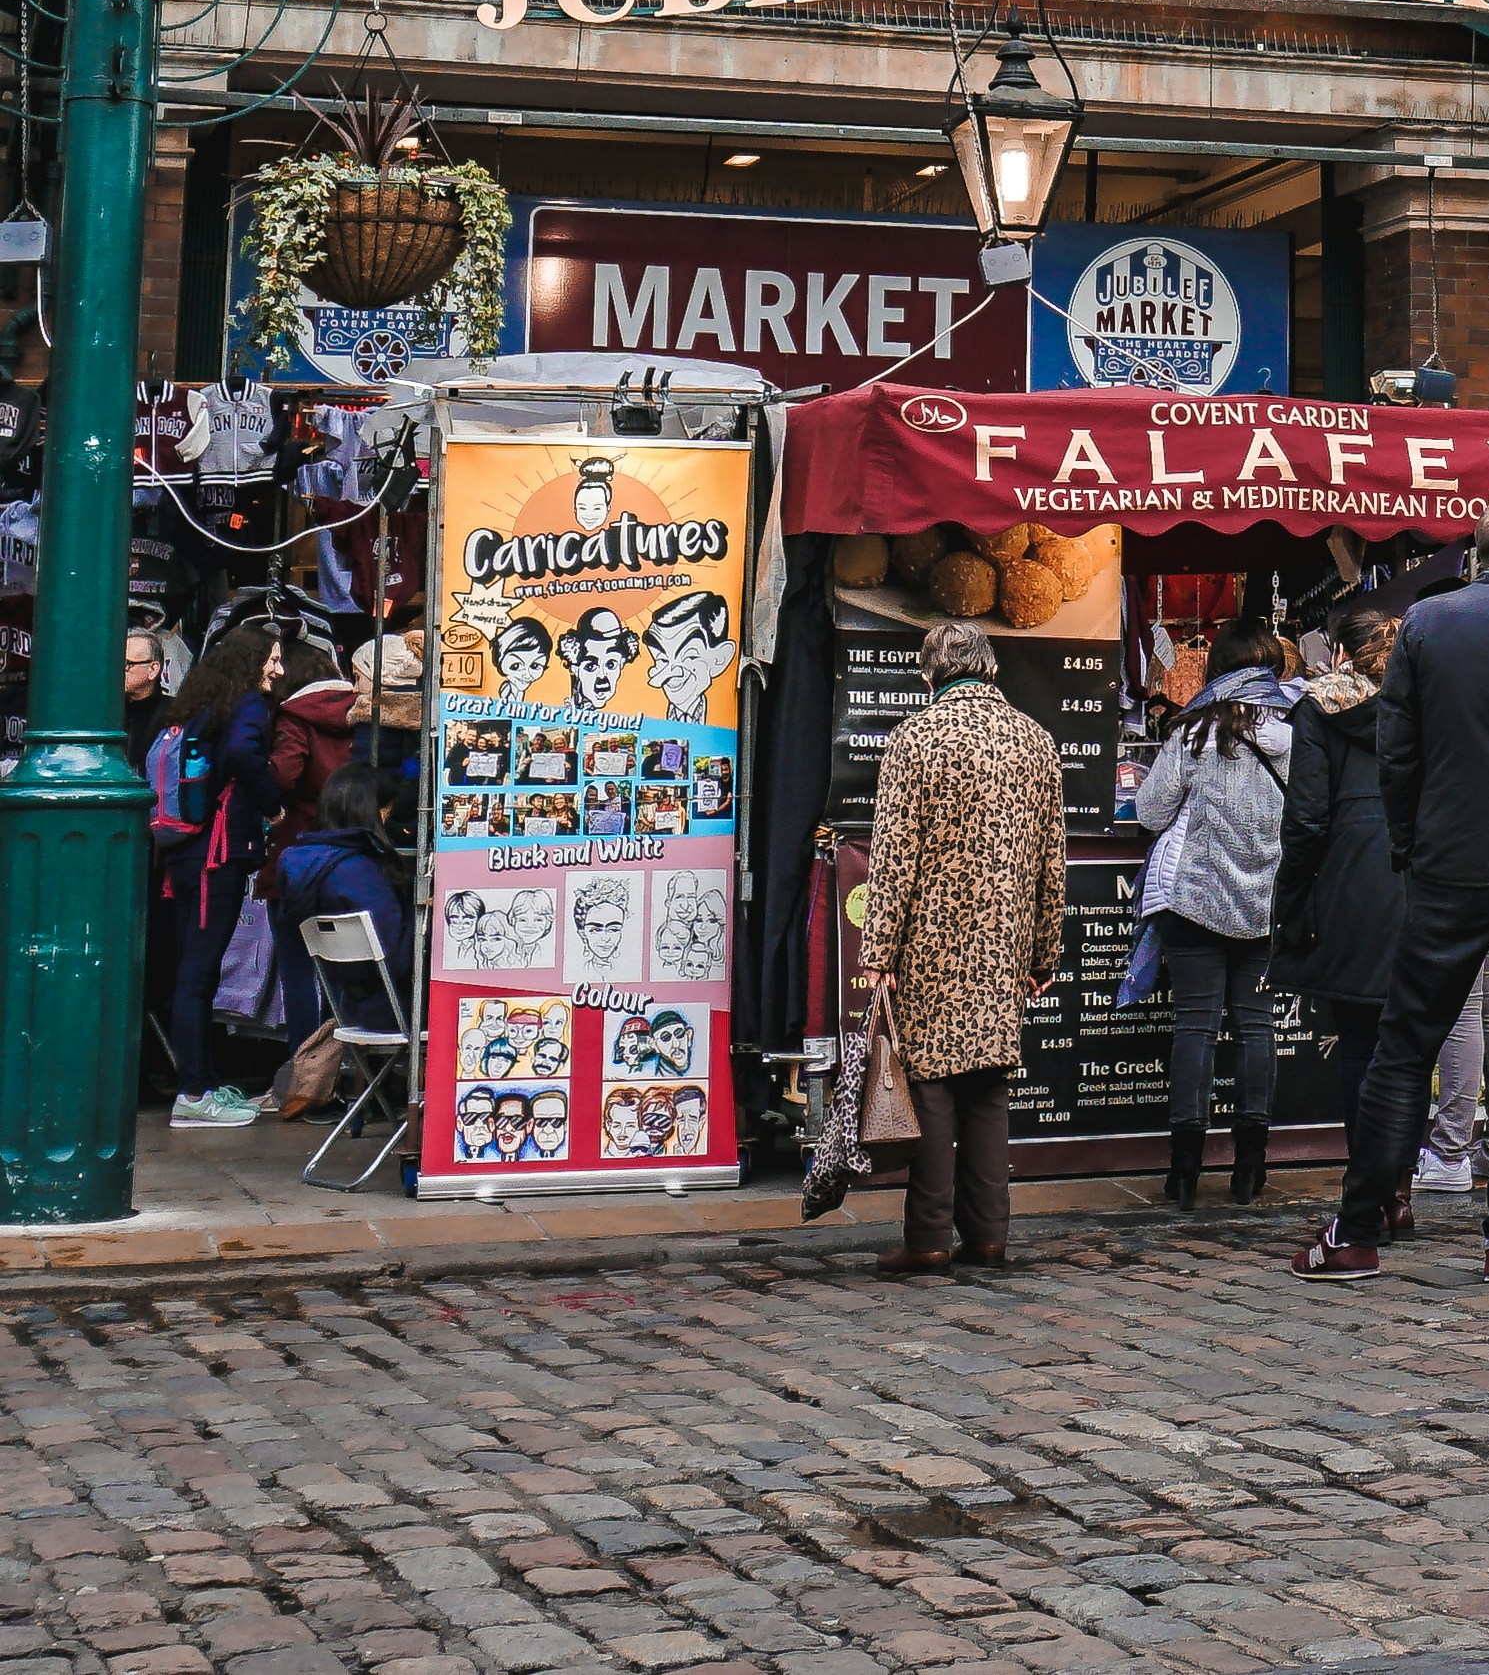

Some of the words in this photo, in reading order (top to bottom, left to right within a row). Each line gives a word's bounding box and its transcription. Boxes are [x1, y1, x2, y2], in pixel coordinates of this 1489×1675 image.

[1098, 273, 1210, 308] JUBILEE
[319, 309, 334, 318] IN
[342, 309, 369, 320] THE
[592, 262, 970, 359] MARKET
[320, 318, 378, 329] COVENT
[1096, 300, 1213, 337] MARKET
[1117, 339, 1141, 349] THE
[1147, 340, 1186, 350] HEART
[1194, 341, 1209, 351] OF
[1157, 349, 1209, 359] GARDEN
[912, 401, 957, 425] حلال
[1150, 401, 1258, 427] COVENT
[1266, 403, 1370, 431] GARDEN
[1013, 485, 1183, 513] VEGETARIAN
[1192, 489, 1214, 512] &
[1222, 485, 1427, 519] MEDITERRANEAN
[464, 511, 729, 579] Caricatures
[847, 649, 874, 663] THE
[1063, 656, 1103, 671] £4.95
[848, 690, 875, 705] THE
[1061, 699, 1103, 712] £4.95
[445, 694, 493, 716] Great
[496, 697, 528, 720] fun
[530, 702, 561, 723] for
[564, 705, 644, 731] everyone!
[1060, 743, 1101, 756] £6.00
[488, 844, 547, 871] Black
[552, 839, 592, 866] and
[597, 835, 665, 863] White
[1080, 905, 1123, 916] hummus
[1082, 922, 1113, 937] The
[1081, 970, 1107, 981] salad
[572, 981, 655, 1015] Colour
[1081, 991, 1112, 1006] The
[1033, 1014, 1062, 1024] mixed
[1080, 1012, 1108, 1022] Mixed
[1080, 1026, 1108, 1036] mixed
[1110, 1025, 1135, 1034] salad
[1137, 1024, 1156, 1034] with
[1286, 1031, 1313, 1041] salad
[1041, 1038, 1073, 1049] £4.95
[1079, 1062, 1110, 1076] The
[1114, 1059, 1165, 1075] Greek
[1017, 1086, 1049, 1097] potato
[1078, 1082, 1106, 1093] Greek
[1109, 1081, 1133, 1091] salad
[1136, 1080, 1164, 1090] mixed
[1008, 1099, 1034, 1109] salad
[1036, 1099, 1055, 1109] and
[1077, 1096, 1106, 1107] mixed
